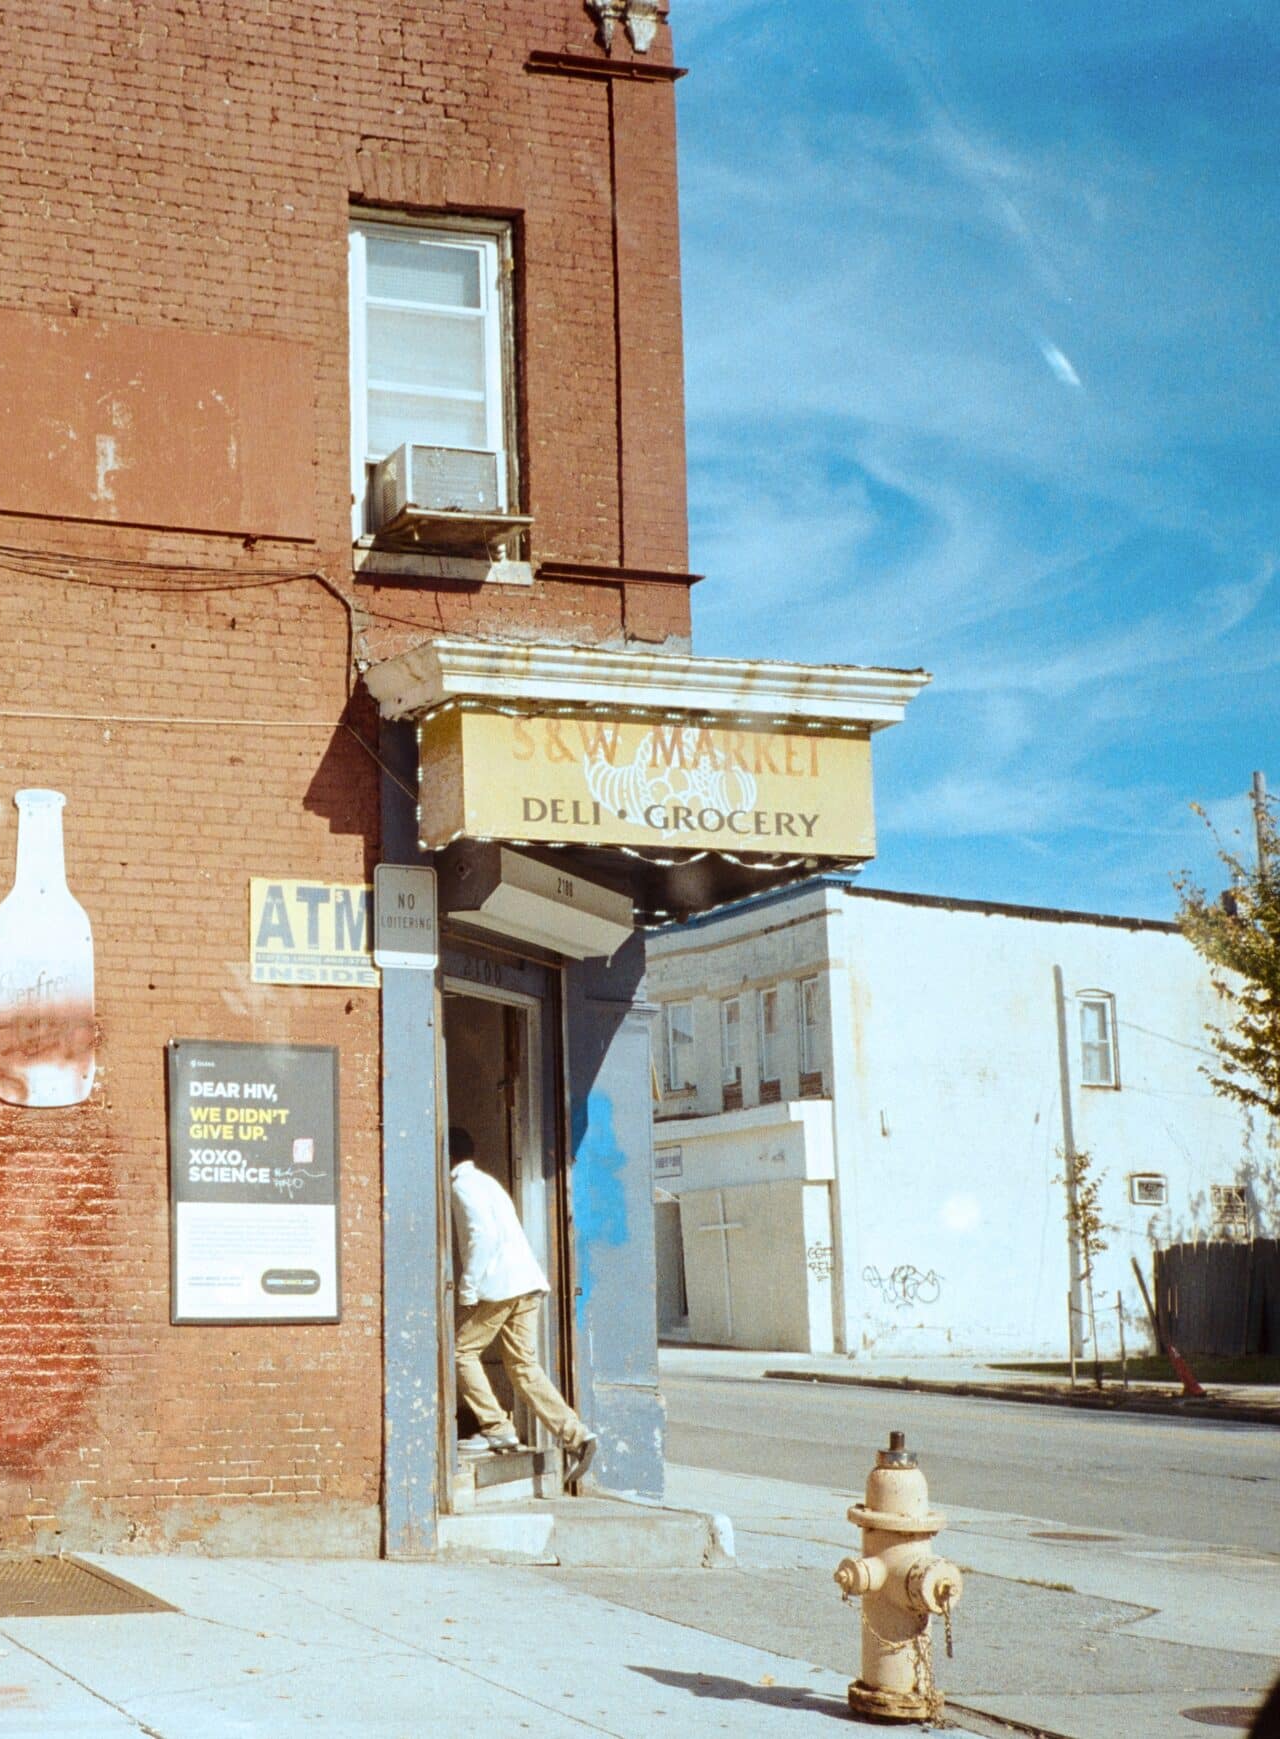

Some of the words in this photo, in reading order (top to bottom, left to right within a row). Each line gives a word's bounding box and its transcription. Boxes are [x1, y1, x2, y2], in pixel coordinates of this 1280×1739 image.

[511, 713, 622, 766] S&W
[649, 723, 821, 778] MARKET
[522, 796, 602, 826] DELI
[644, 804, 820, 838] GROCERY
[397, 893, 416, 909] NO
[255, 884, 374, 951] ATM
[381, 915, 433, 931] LOITERING
[255, 967, 377, 984] INSIDE
[189, 1081, 240, 1098] DEAR
[243, 1083, 279, 1102] HIV,
[189, 1107, 221, 1123] WE
[225, 1108, 290, 1125] DIDN'T
[189, 1125, 234, 1140] GIVE
[238, 1126, 268, 1141] UP.
[189, 1149, 247, 1168] XOXO,
[188, 1167, 271, 1184] SCIENCE
